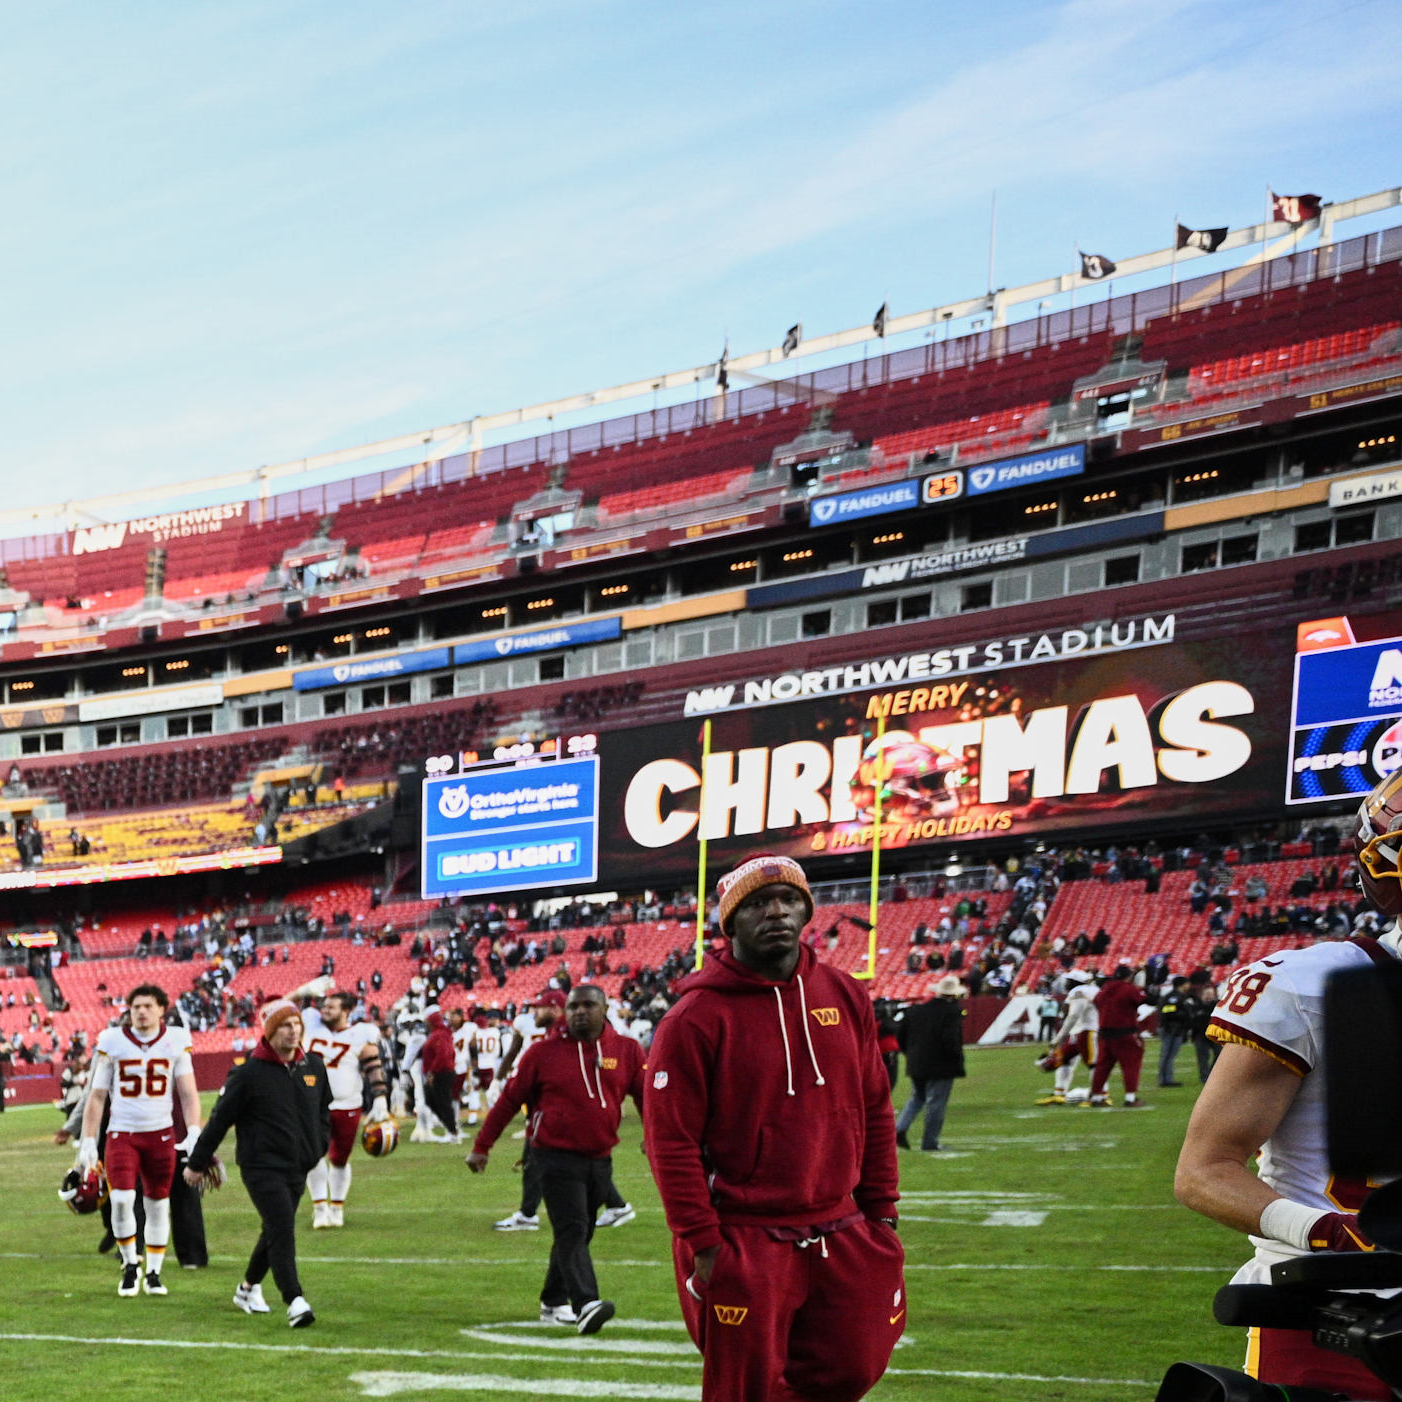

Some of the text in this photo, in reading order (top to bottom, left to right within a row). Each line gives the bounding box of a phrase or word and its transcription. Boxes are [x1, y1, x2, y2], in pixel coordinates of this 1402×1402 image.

[998, 453, 1082, 483] FANDUEL
[839, 487, 916, 514] FANDUEL
[927, 474, 959, 497] 25
[73, 502, 246, 556] NW NORTHWEST
[152, 520, 223, 543] STADIUM
[862, 538, 1029, 588] NW NORTHWEST
[514, 630, 572, 650] FANDUEL
[743, 646, 977, 704] NORTHWEST
[984, 614, 1176, 668] STADIUM
[866, 682, 970, 720] MERRY
[1294, 750, 1367, 773] PEPSI
[831, 822, 903, 850] HAPPY
[905, 811, 1014, 841] HOLIDAYS
[442, 842, 575, 877] BUD LIGHT
[308, 1037, 351, 1069] 67
[477, 1036, 496, 1055] 10
[118, 1057, 170, 1099] 56
